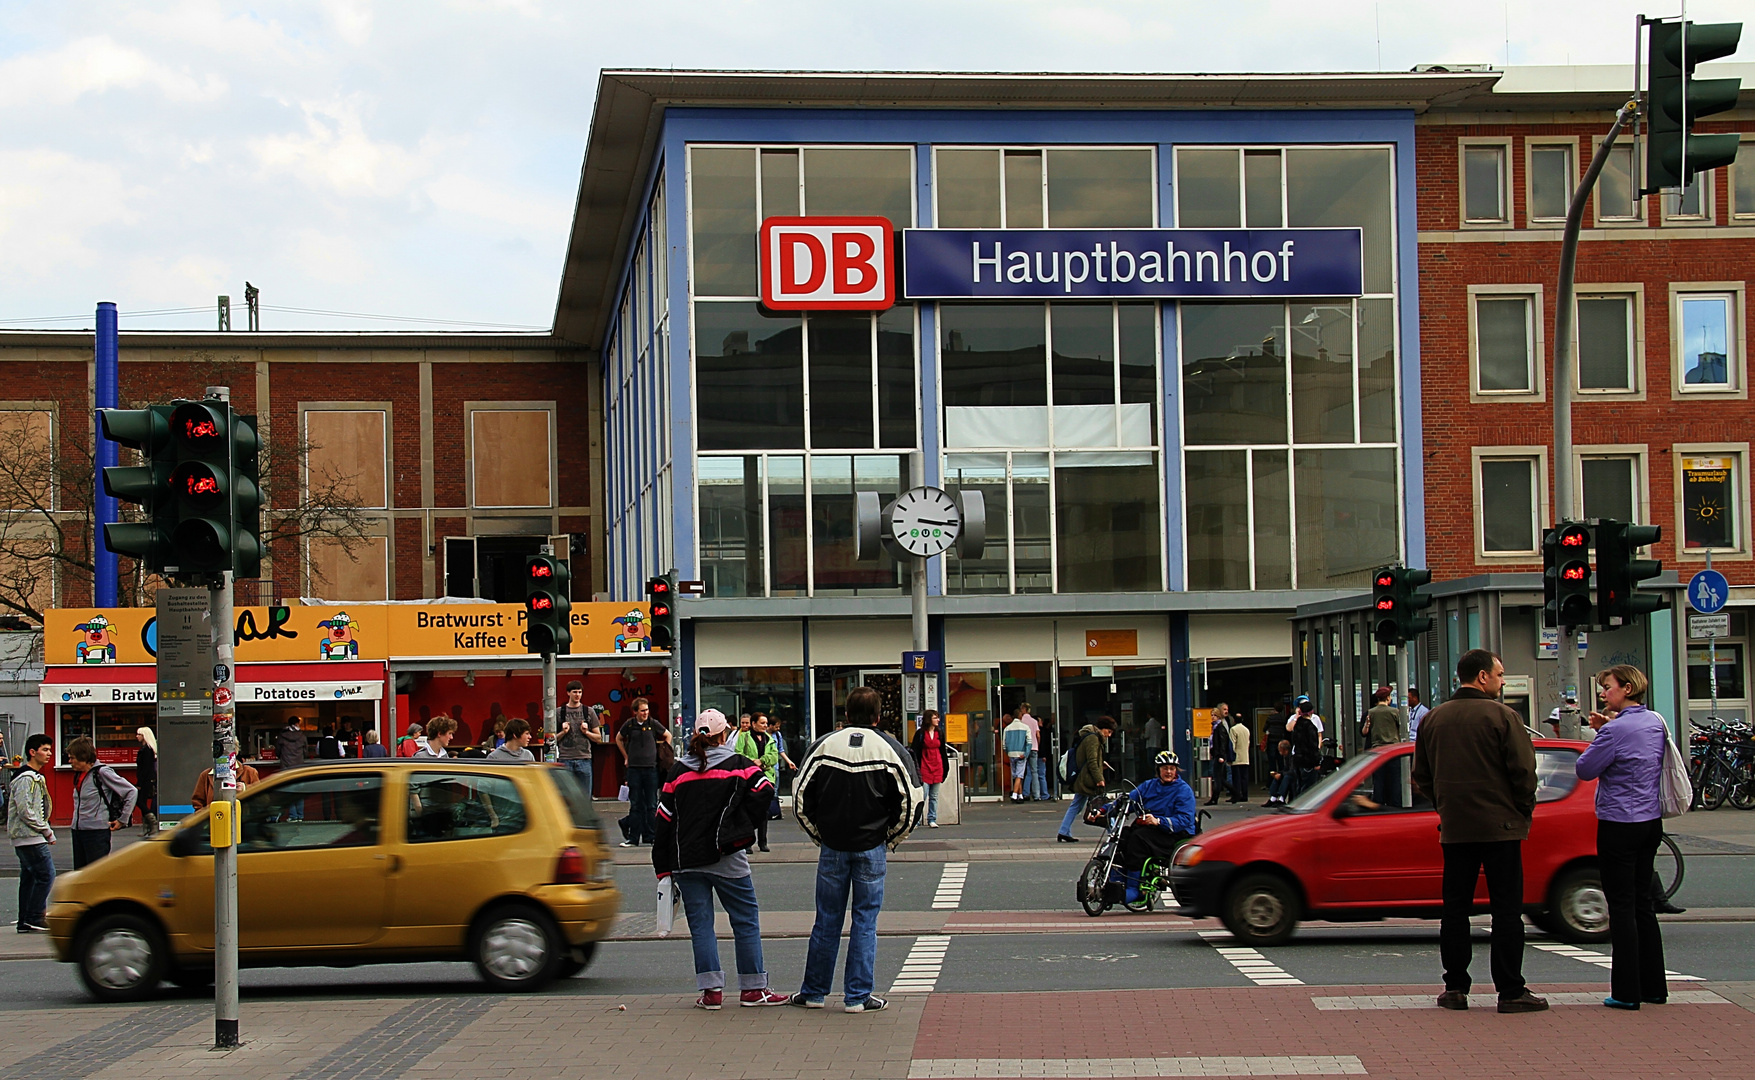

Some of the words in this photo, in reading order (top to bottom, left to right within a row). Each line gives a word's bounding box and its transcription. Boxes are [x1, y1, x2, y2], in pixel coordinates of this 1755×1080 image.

[778, 231, 878, 294] DB
[971, 240, 1295, 293] Hauptbahnhof
[417, 611, 503, 628] Bratwurst
[454, 632, 507, 649] Kaffee
[255, 687, 316, 700] Potatoes
